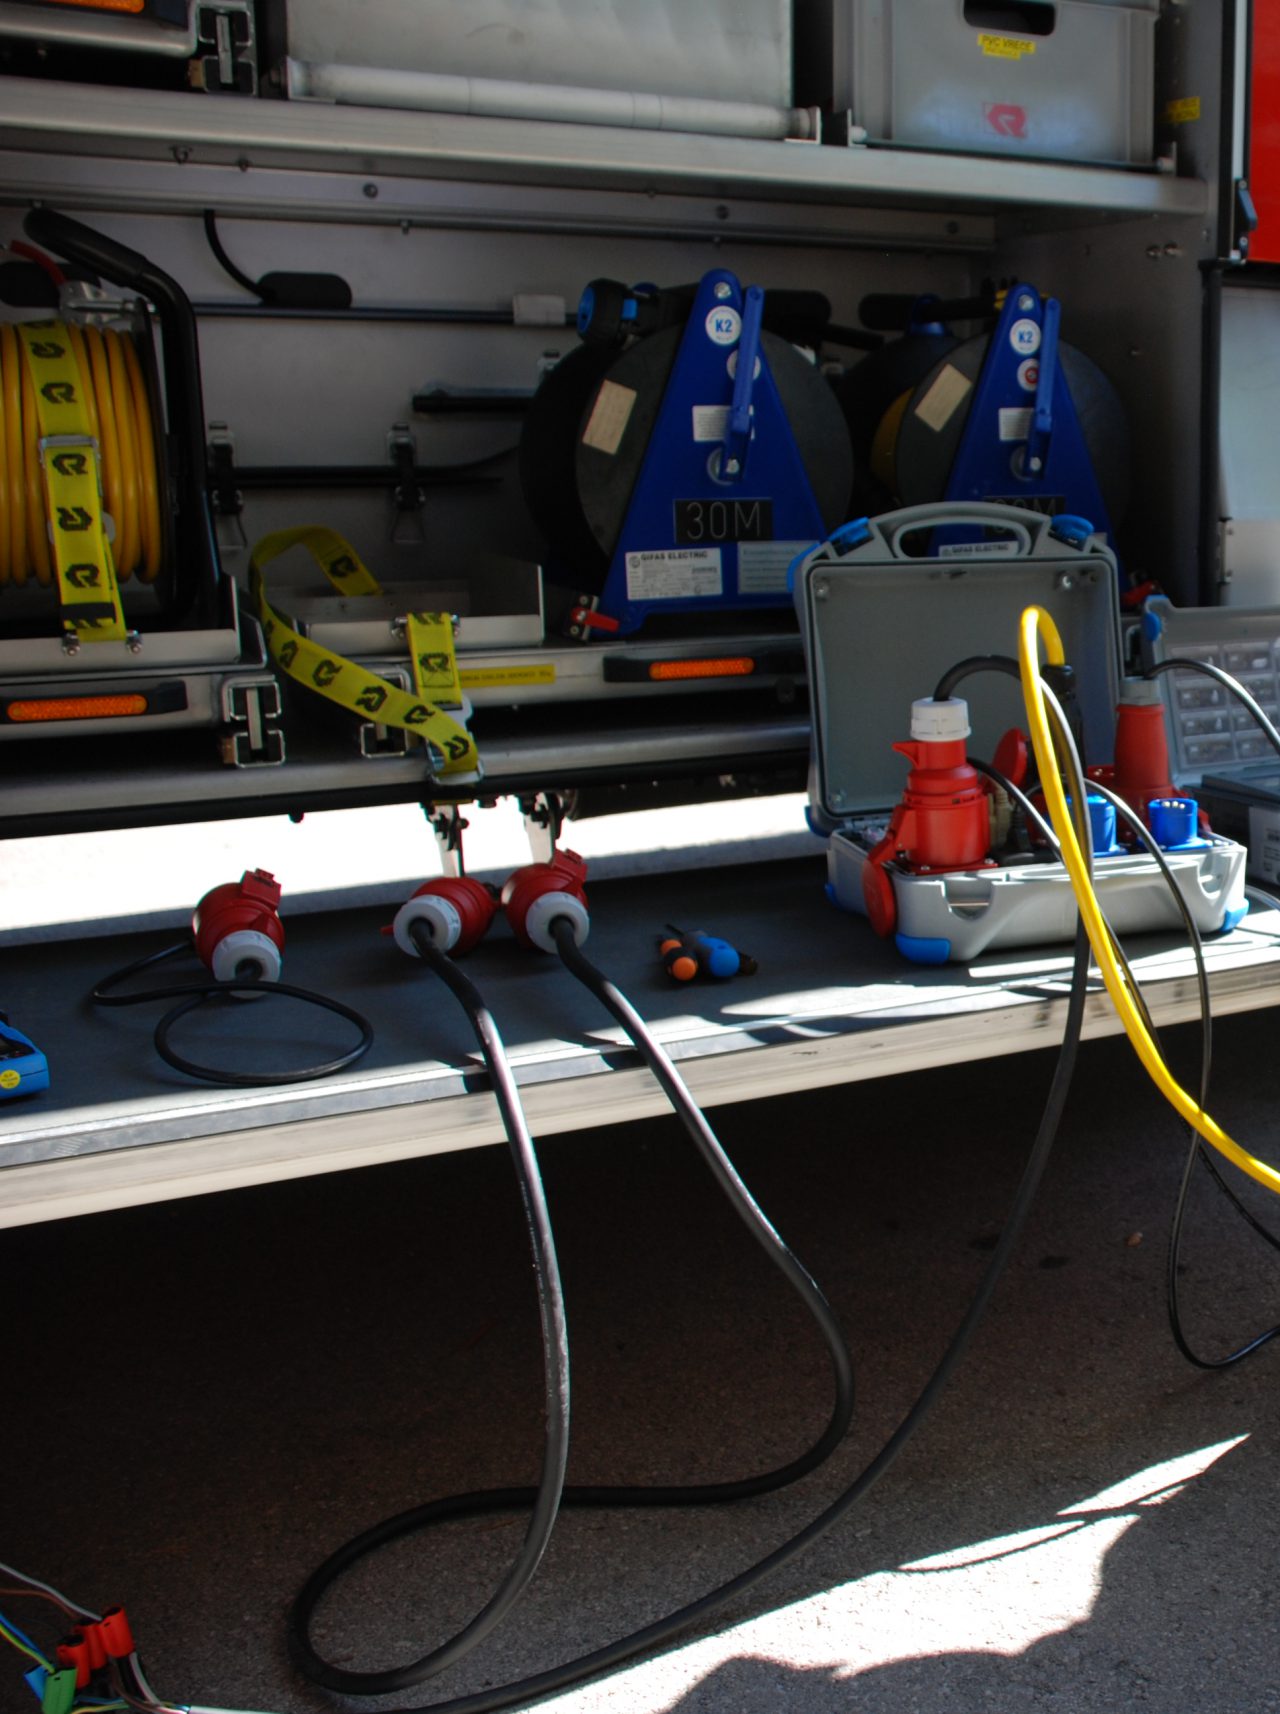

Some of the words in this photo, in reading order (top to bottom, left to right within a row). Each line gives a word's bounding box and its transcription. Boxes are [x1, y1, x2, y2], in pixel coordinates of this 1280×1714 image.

[715, 319, 733, 333] K2
[1018, 331, 1034, 343] K2
[686, 501, 761, 540] 30M
[640, 552, 665, 561] GIFAS
[668, 550, 708, 560] ELECTRIC
